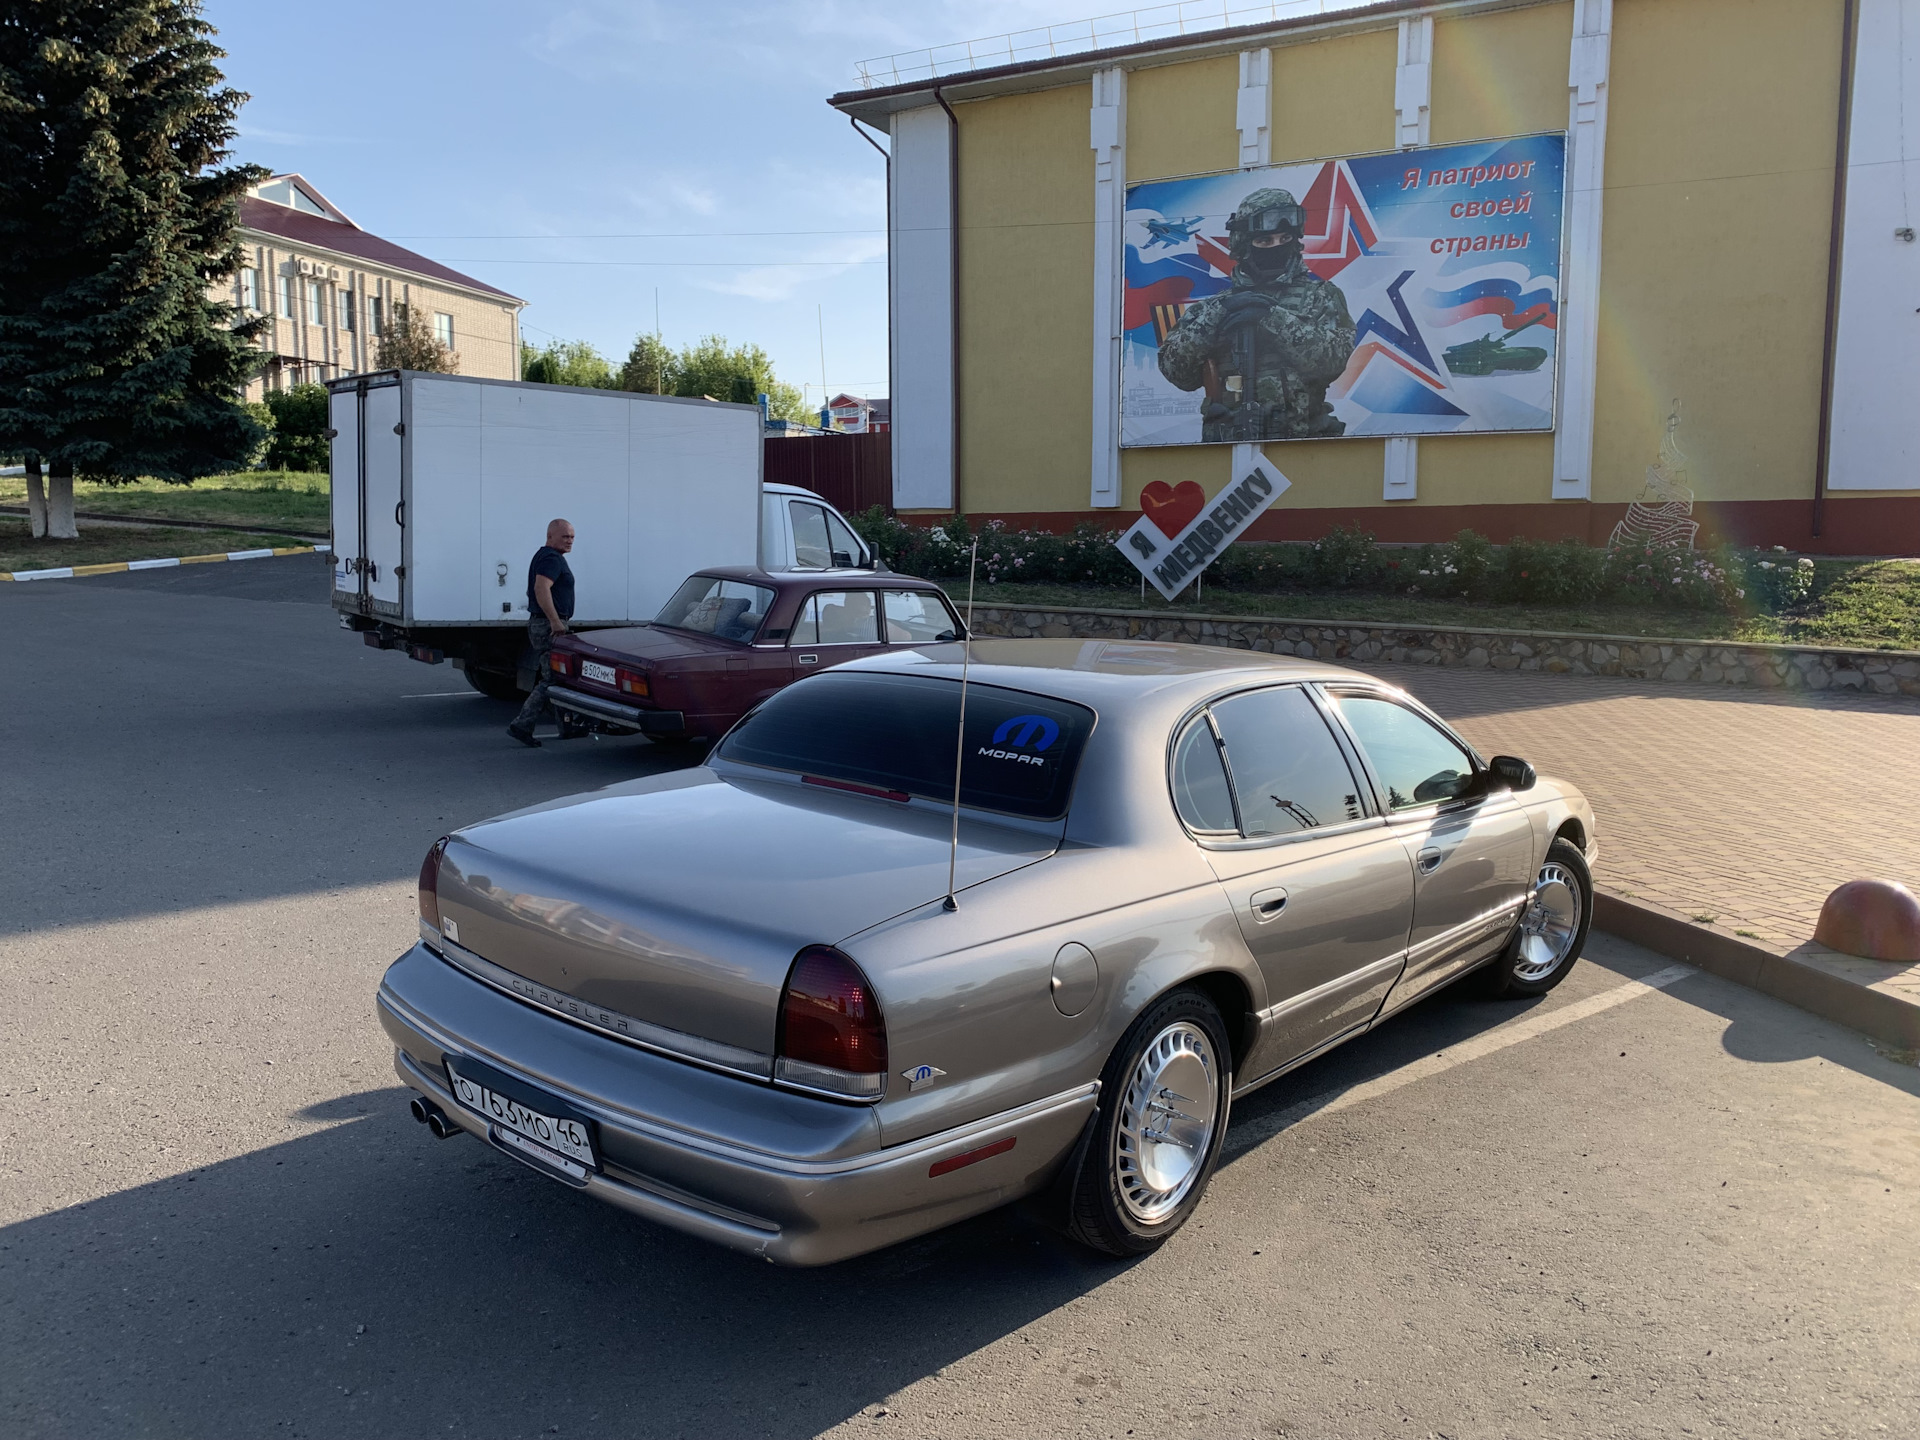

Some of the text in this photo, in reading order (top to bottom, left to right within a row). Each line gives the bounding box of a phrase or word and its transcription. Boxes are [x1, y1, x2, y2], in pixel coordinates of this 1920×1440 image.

[1401, 161, 1536, 191] Я патриот
[1450, 190, 1531, 219] своей
[1430, 231, 1530, 258] страны
[1152, 467, 1273, 590] МЕДВЕНКУ
[1129, 530, 1157, 560] Я
[978, 747, 1044, 766] MOPAR
[512, 980, 628, 1030] CHRYSLER
[556, 1118, 581, 1146] 46
